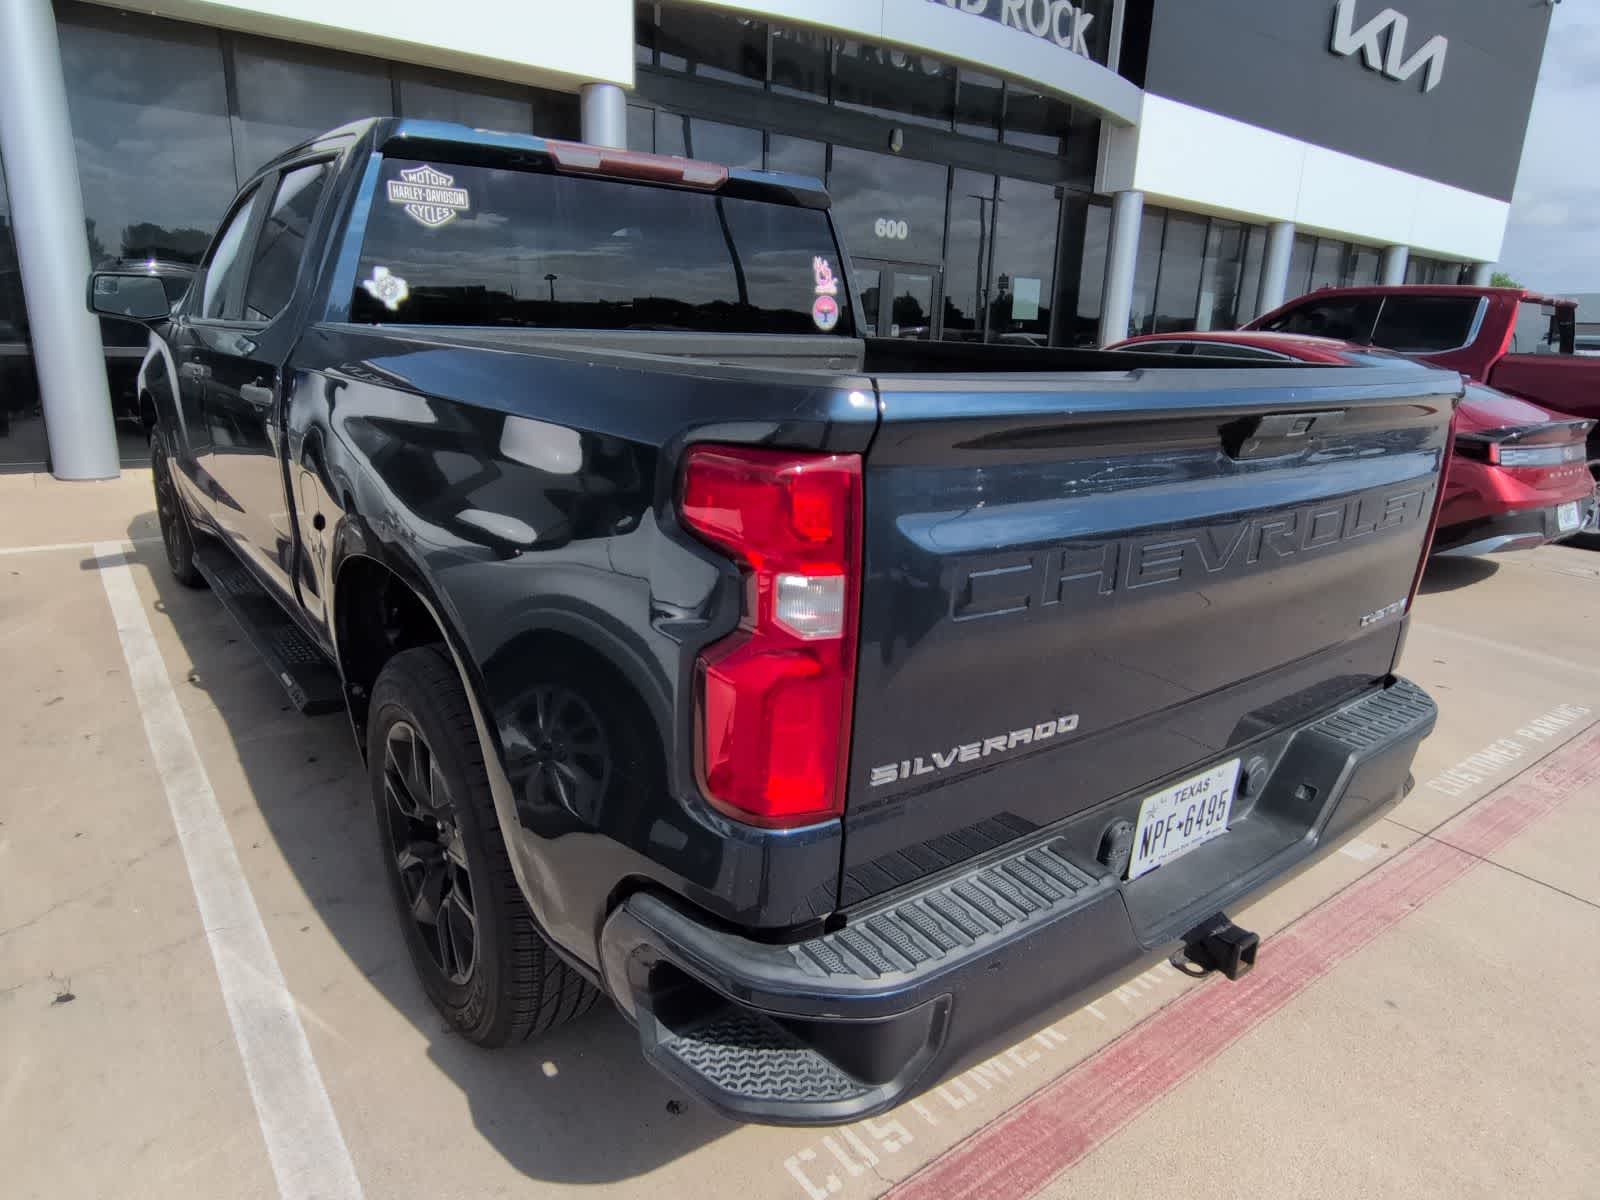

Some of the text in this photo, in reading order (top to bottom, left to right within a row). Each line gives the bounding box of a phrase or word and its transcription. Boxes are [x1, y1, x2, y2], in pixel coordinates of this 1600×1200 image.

[1001, 0, 1094, 59] ROCK
[408, 169, 448, 187] MOTOR
[410, 204, 450, 223] CYCLES
[874, 218, 908, 240] 600
[948, 482, 1434, 622] CHEVROLET
[870, 714, 1080, 787] SILVERADO
[1174, 777, 1211, 806] TEXAS
